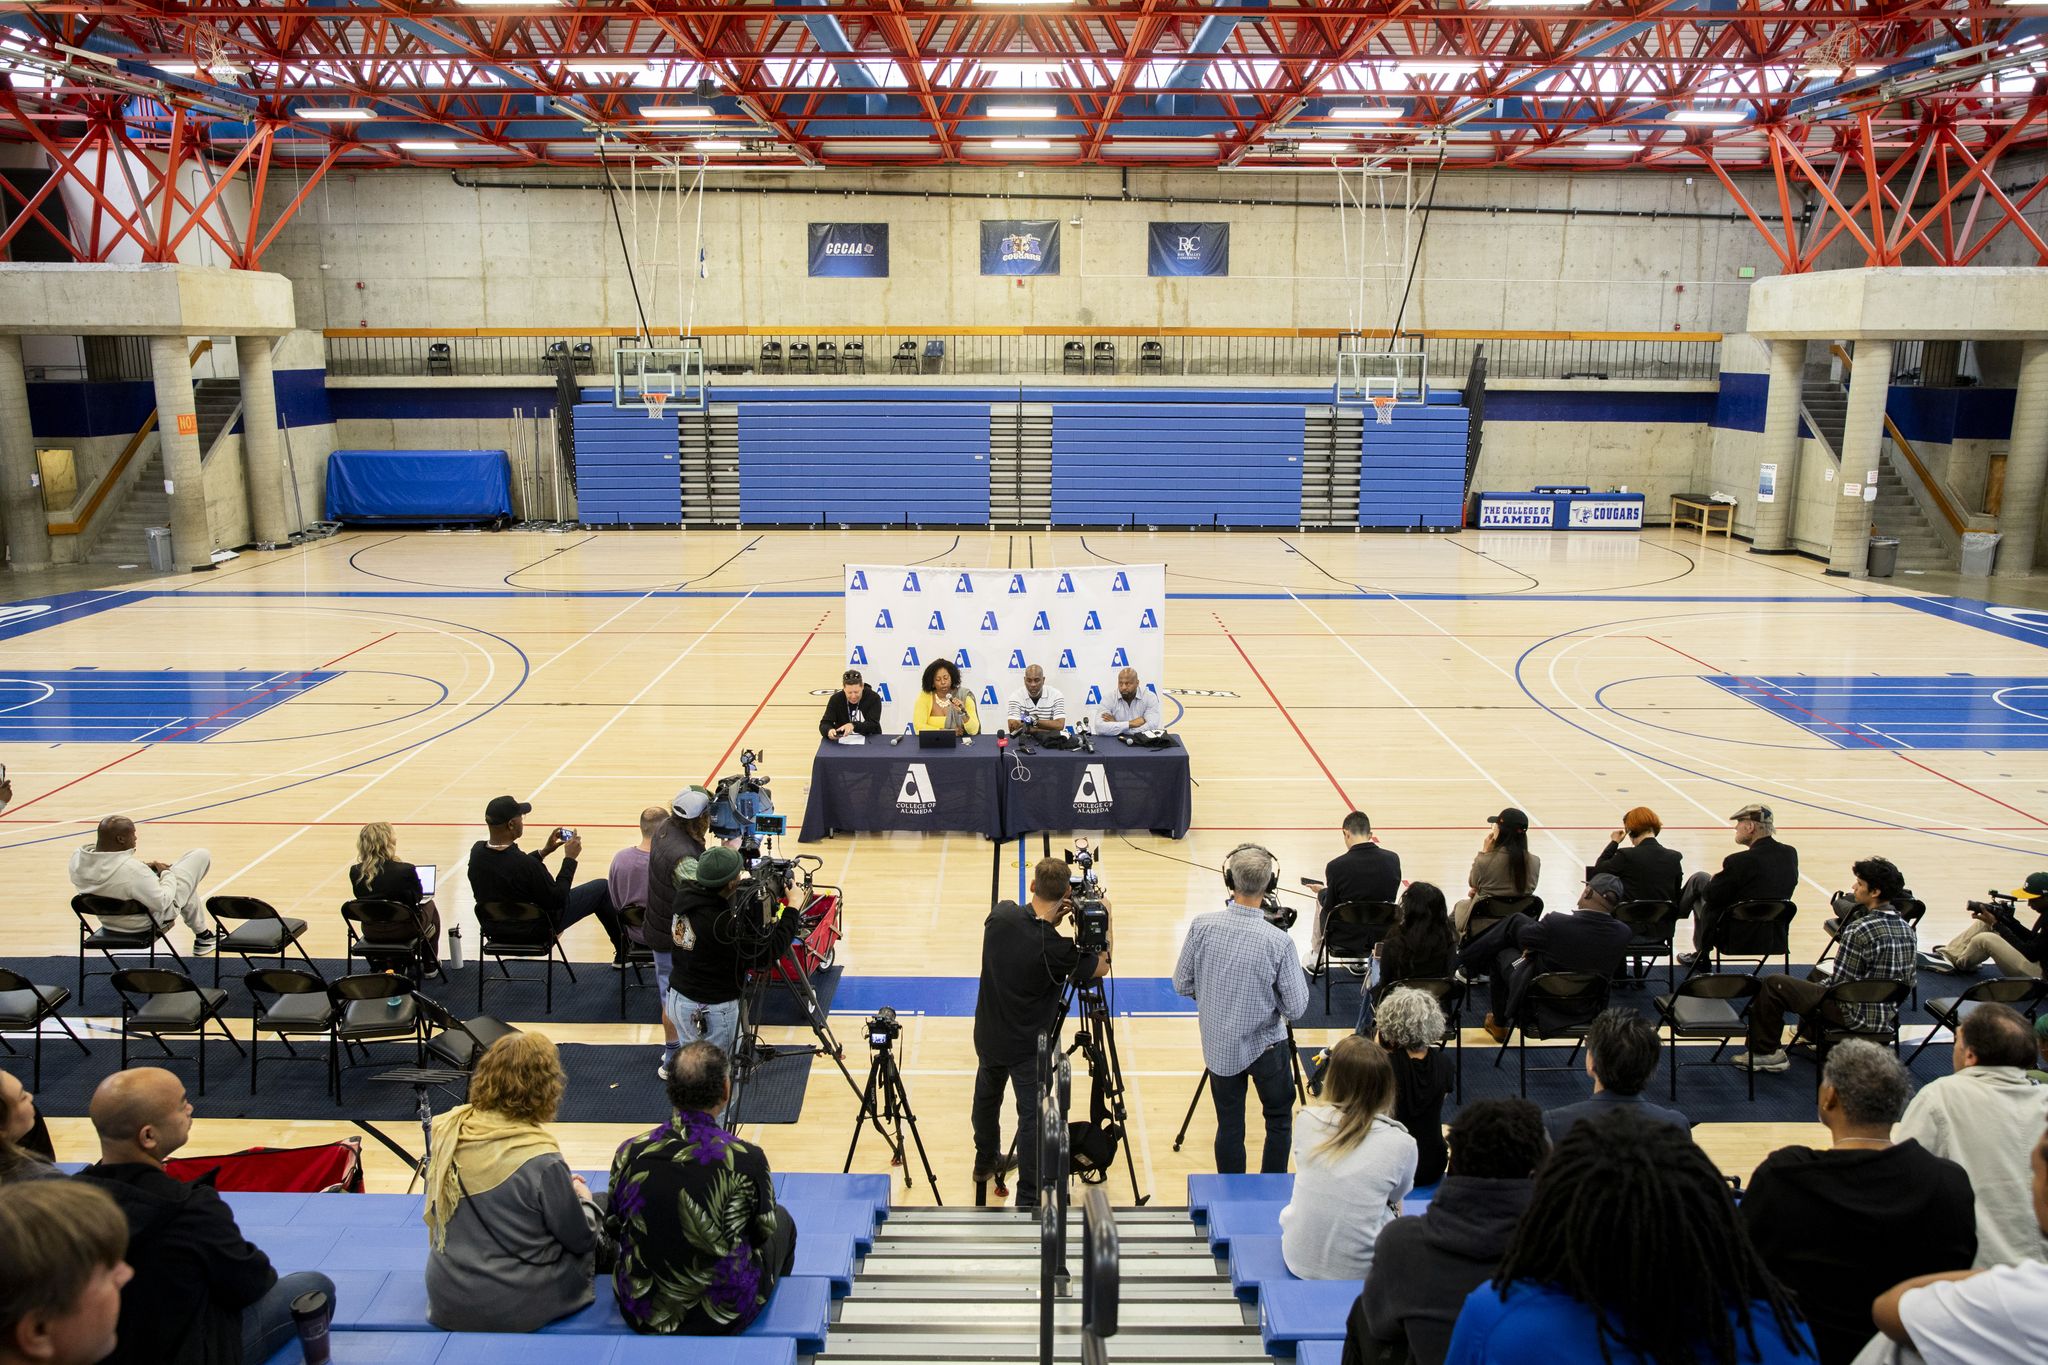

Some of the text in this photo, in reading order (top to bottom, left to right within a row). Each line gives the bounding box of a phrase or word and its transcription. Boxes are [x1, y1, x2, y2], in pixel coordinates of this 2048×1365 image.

[825, 243, 862, 254] CCCAA
[1002, 253, 1041, 262] COUGARS
[1484, 506, 1551, 515] THE COLLEGE OF
[1593, 507, 1639, 520] COUGARS
[1483, 515, 1550, 524] ALAMEDA
